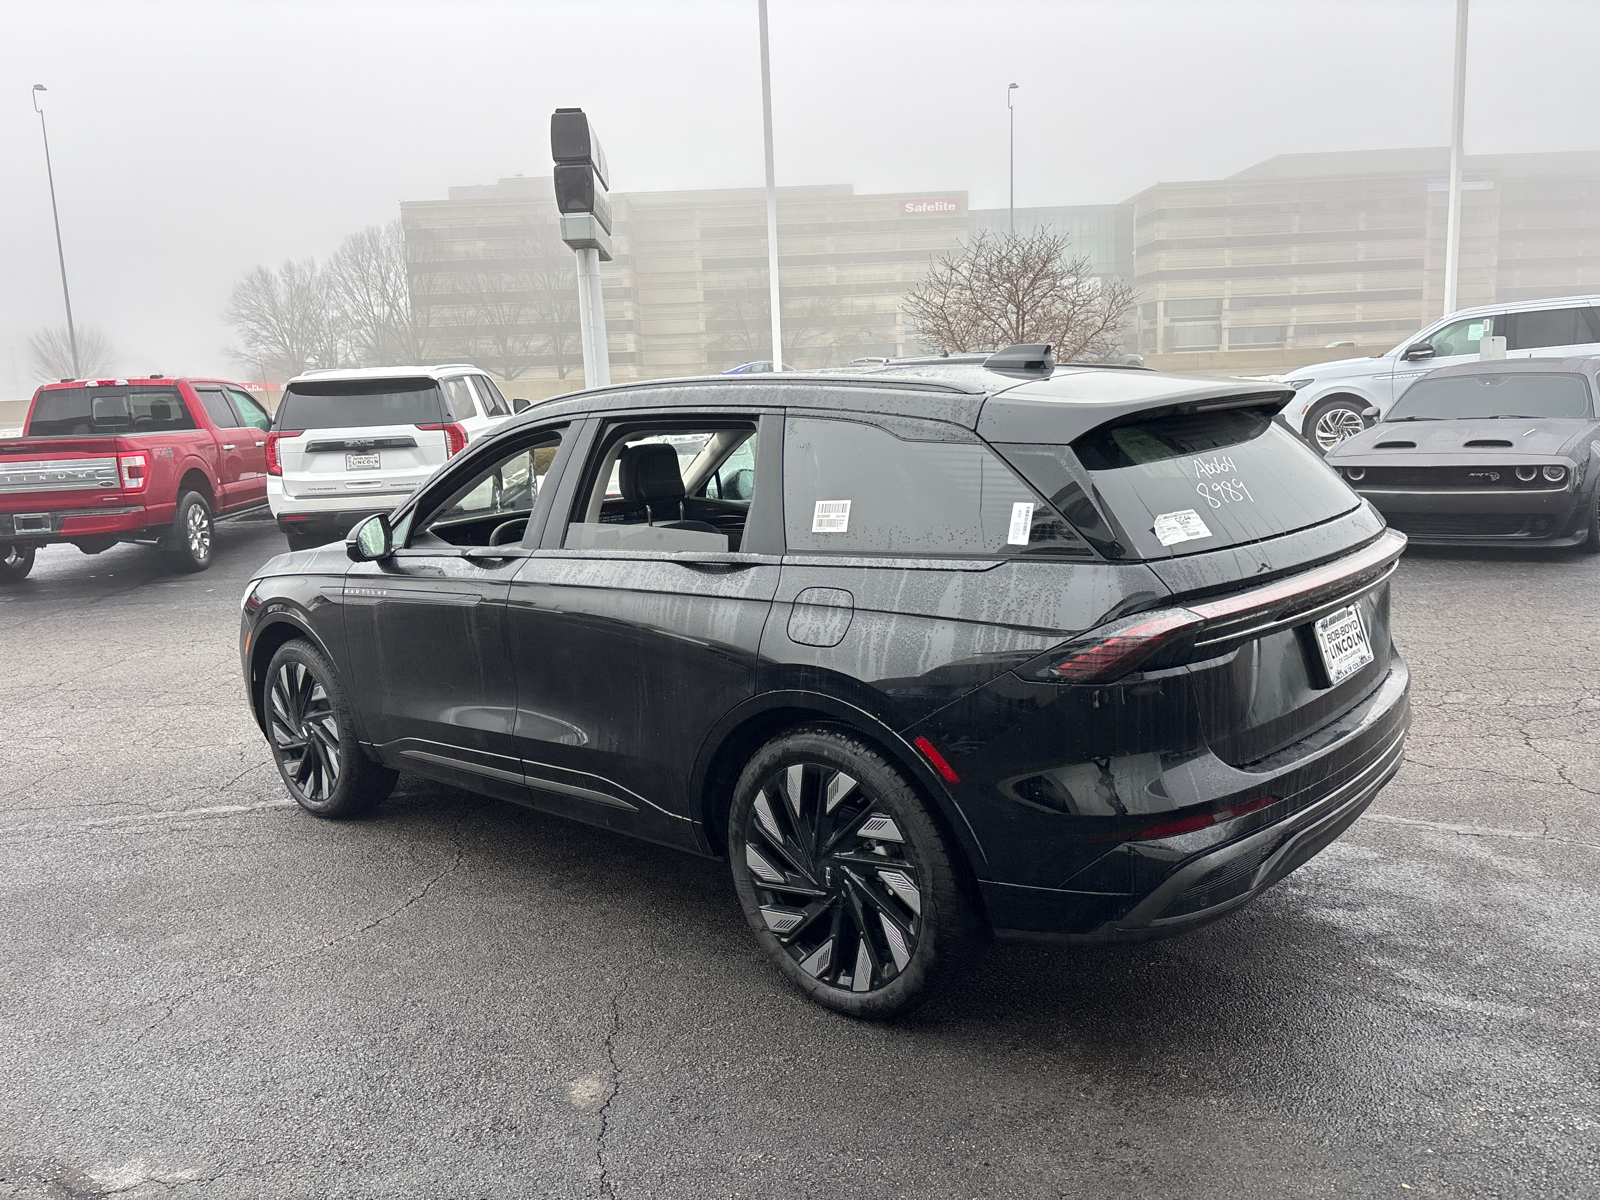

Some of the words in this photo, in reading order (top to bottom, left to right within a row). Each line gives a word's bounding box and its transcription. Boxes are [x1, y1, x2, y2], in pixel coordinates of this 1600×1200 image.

[905, 201, 956, 213] Safelite
[1326, 619, 1358, 644] BOB-BOYD
[1328, 630, 1364, 659] LINCOLN
